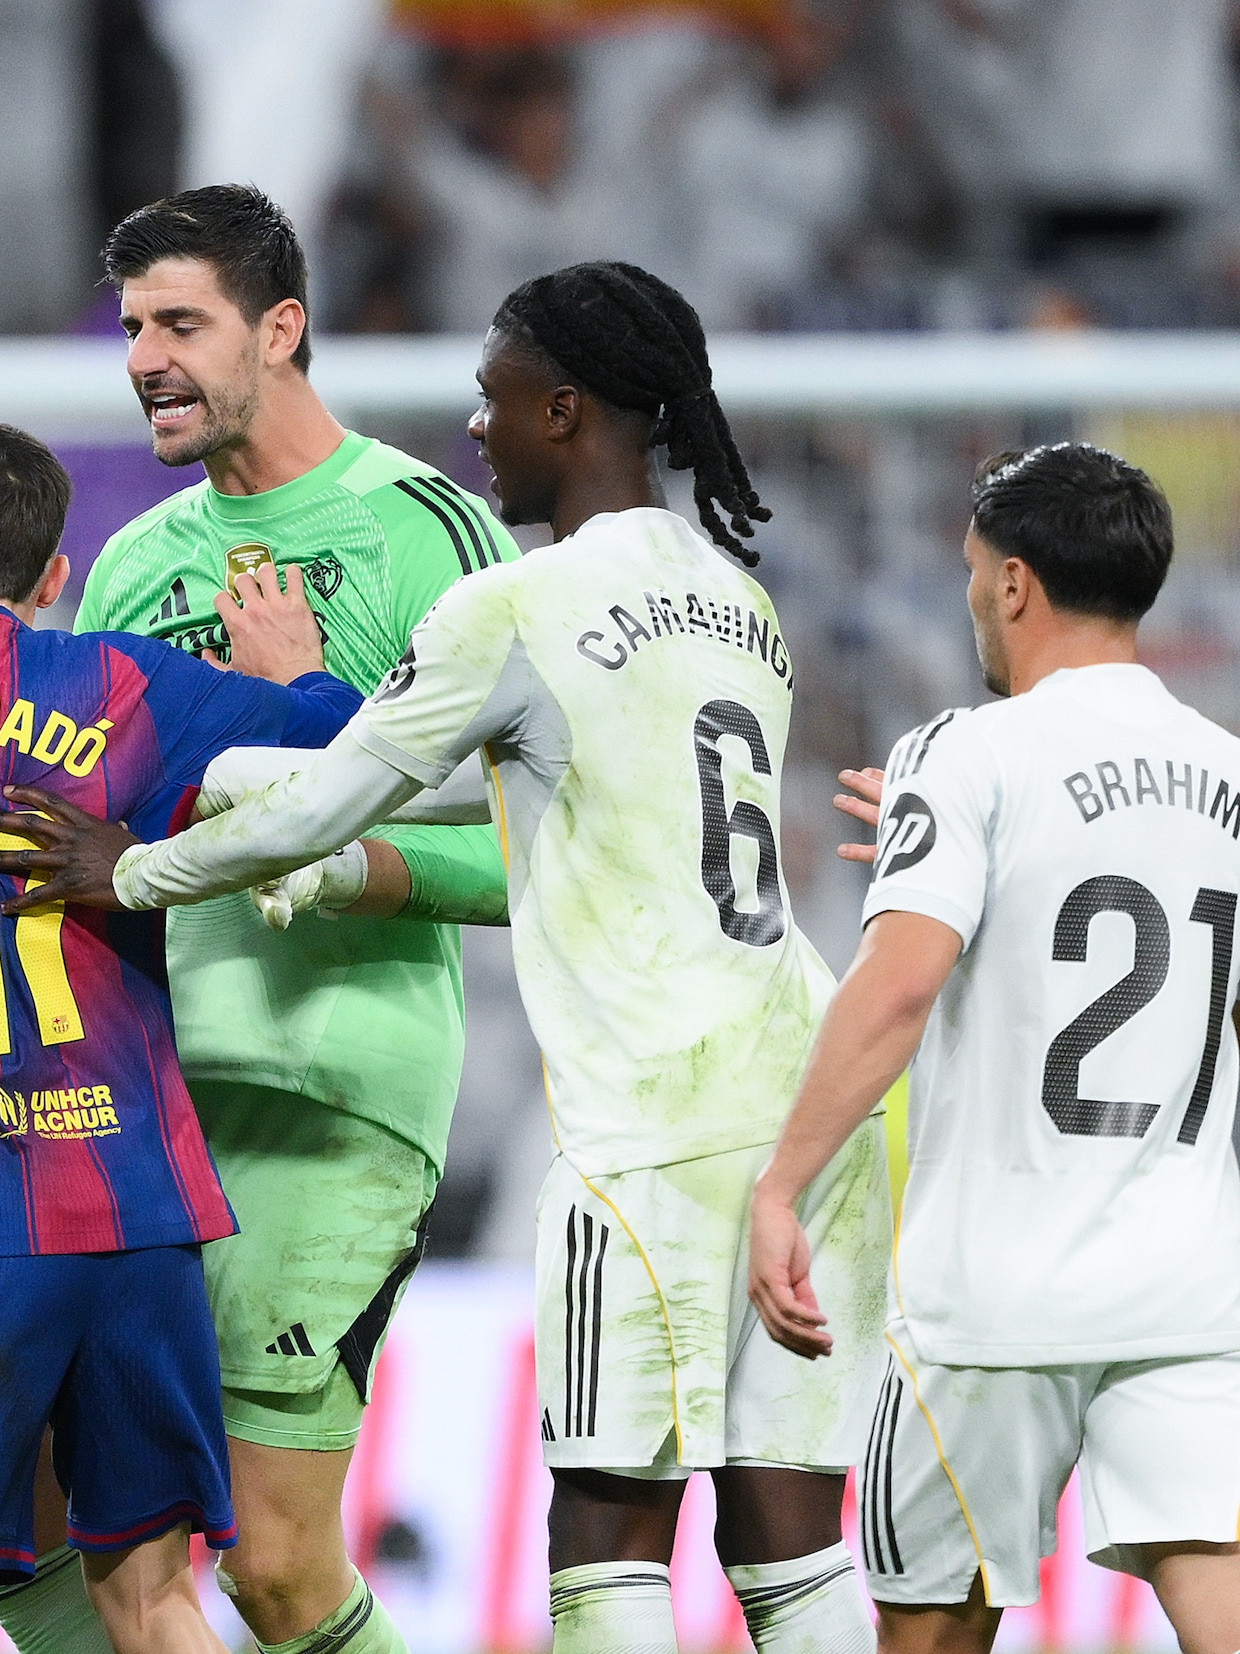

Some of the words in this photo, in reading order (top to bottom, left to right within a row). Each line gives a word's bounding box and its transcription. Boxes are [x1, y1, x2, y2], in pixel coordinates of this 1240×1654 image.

[575, 588, 794, 692] CAMAVING
[693, 698, 787, 948] 6
[1062, 757, 1240, 841] BRAHIM
[1041, 874, 1239, 1147] 21
[30, 1084, 114, 1112] UNHCR
[33, 1105, 120, 1132] ACNUR
[62, 1130, 93, 1140] Refugee
[93, 1126, 122, 1138] Agency
